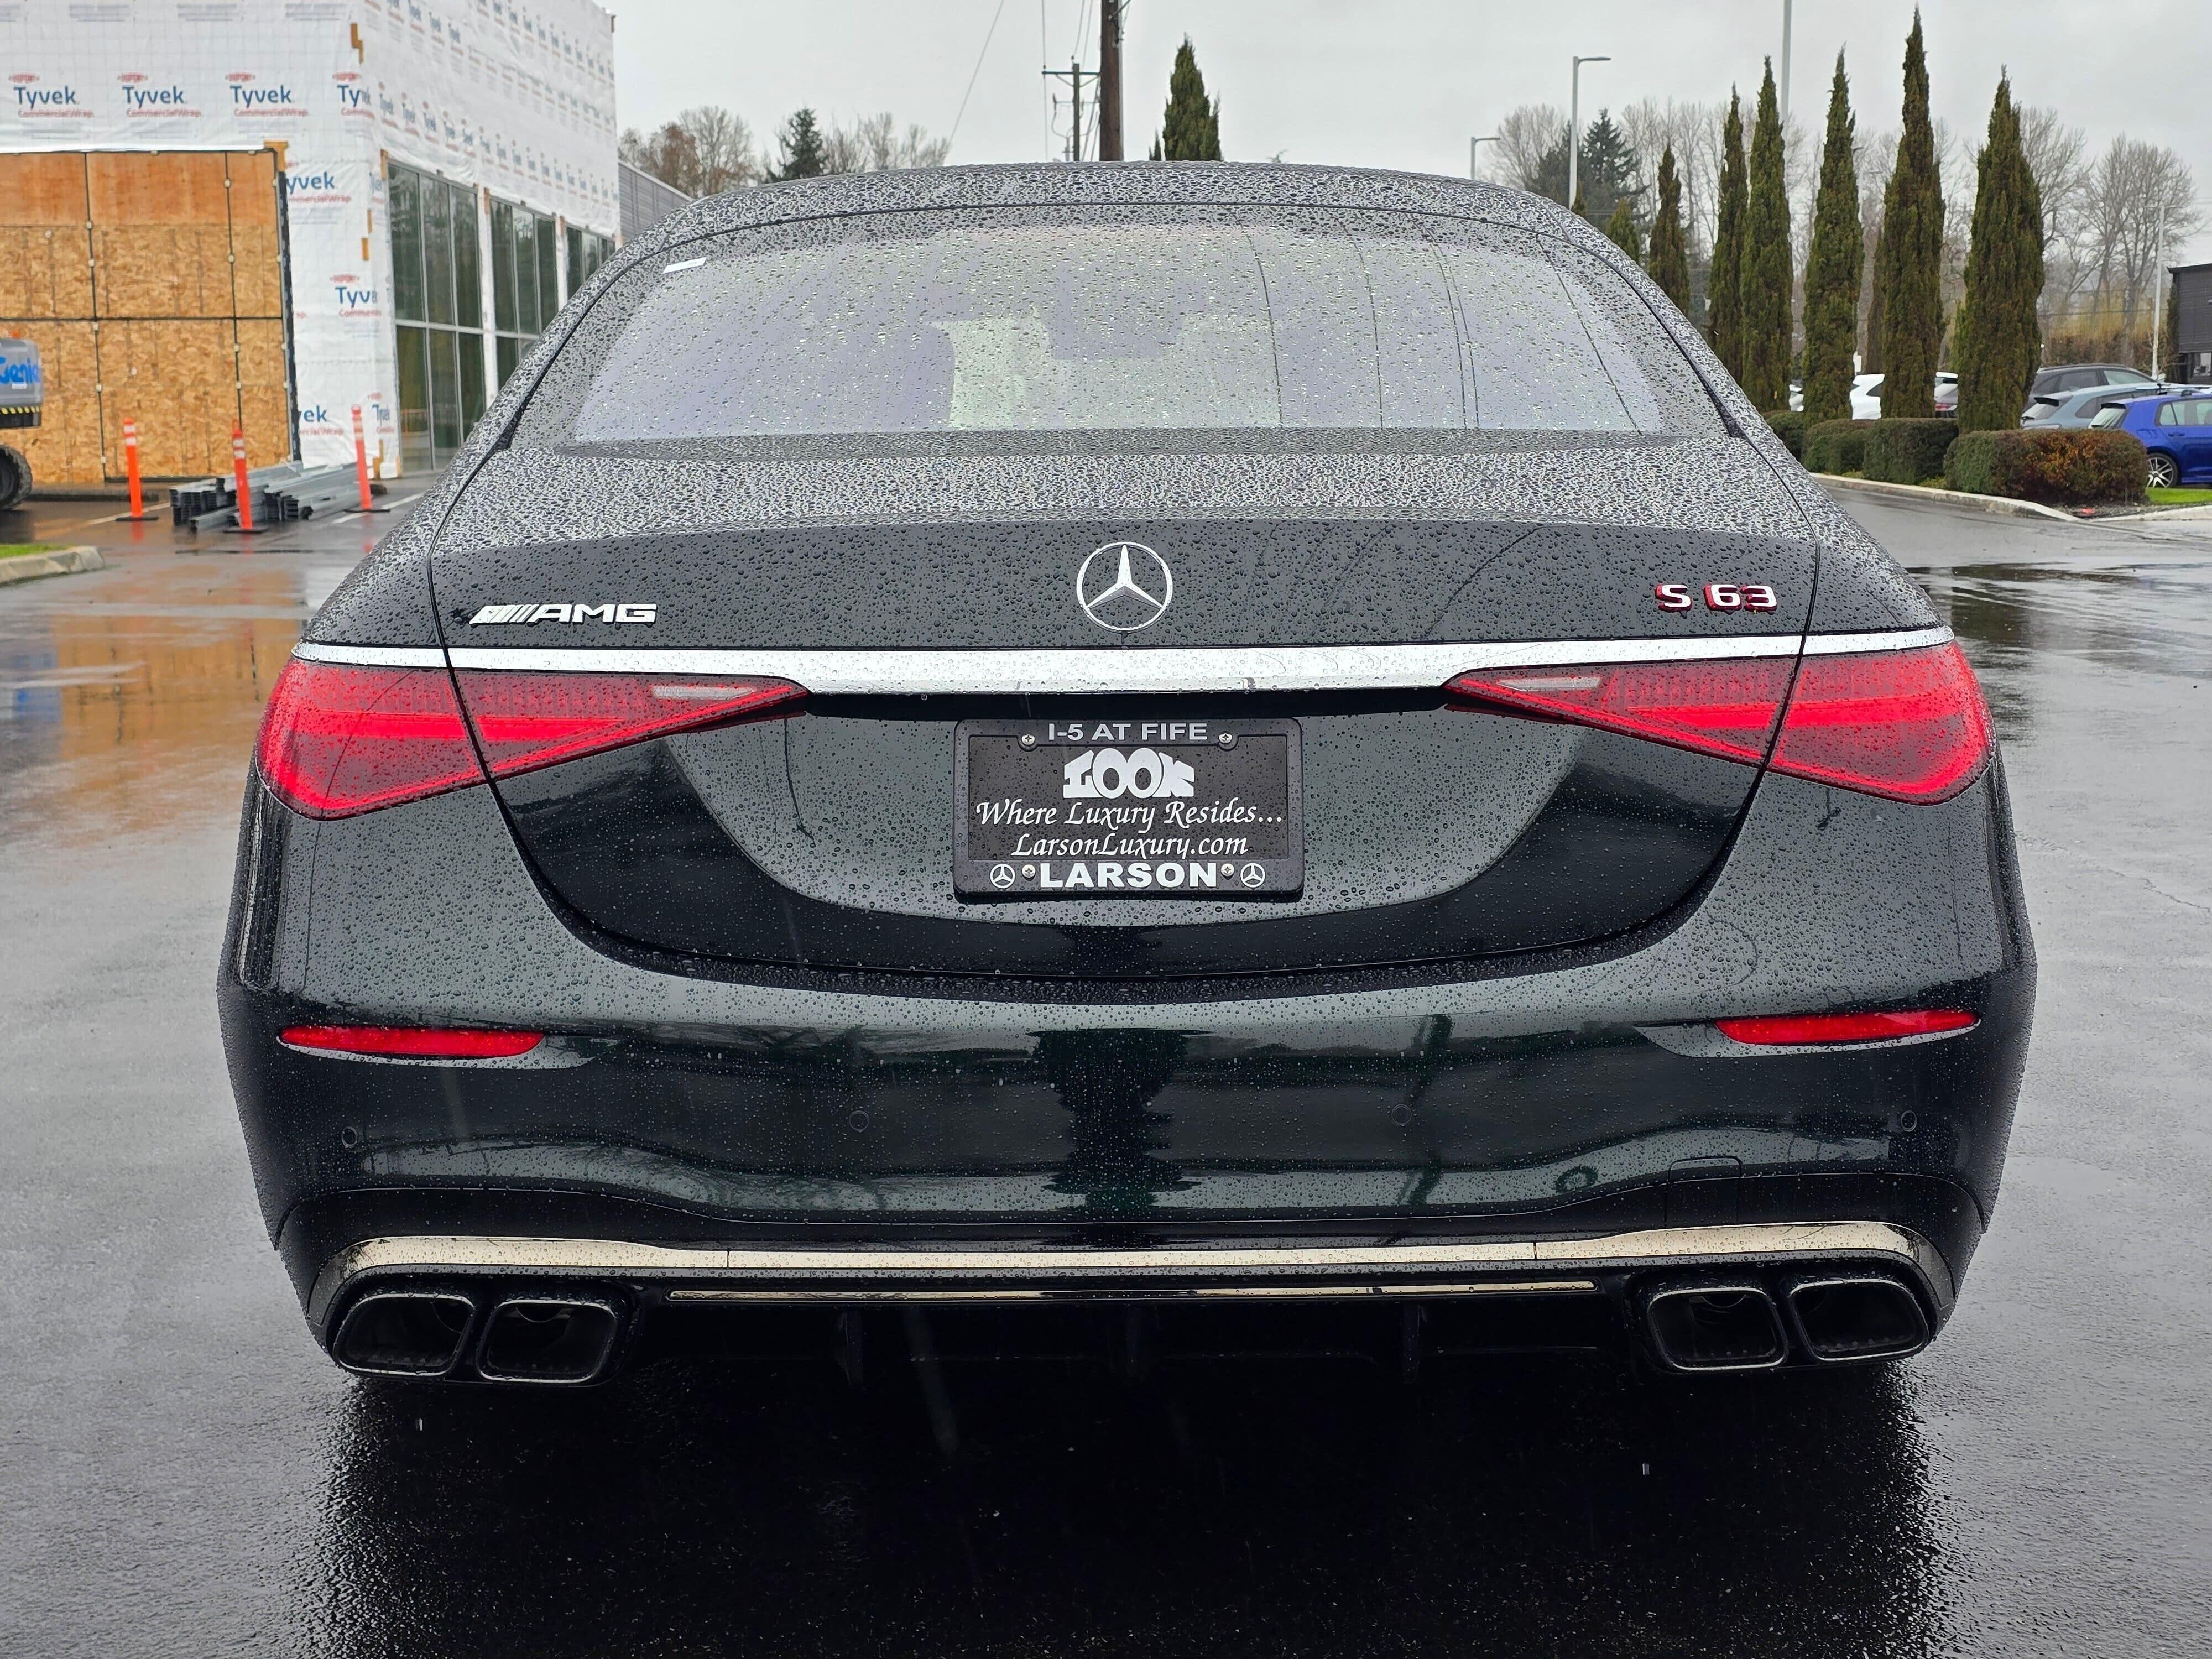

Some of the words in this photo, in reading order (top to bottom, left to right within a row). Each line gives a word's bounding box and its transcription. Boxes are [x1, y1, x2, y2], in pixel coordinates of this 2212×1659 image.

[13, 85, 76, 109] Tyvek
[122, 85, 184, 109] Tyvek
[229, 85, 291, 108] Tyvek
[285, 171, 335, 195] yvek
[1655, 584, 1692, 612] S
[1704, 584, 1777, 612] 63
[526, 603, 658, 623] AMG
[1048, 723, 1083, 740] I-5
[1091, 723, 1131, 740] AT
[1141, 722, 1208, 740] FIFE
[1062, 747, 1195, 799] LOOK
[975, 798, 1057, 825] Where
[1063, 802, 1156, 833] Luxury
[1164, 797, 1282, 829] Resides...
[1010, 832, 1248, 860] LarsonLuxury.com
[1040, 862, 1217, 888] LARSON
